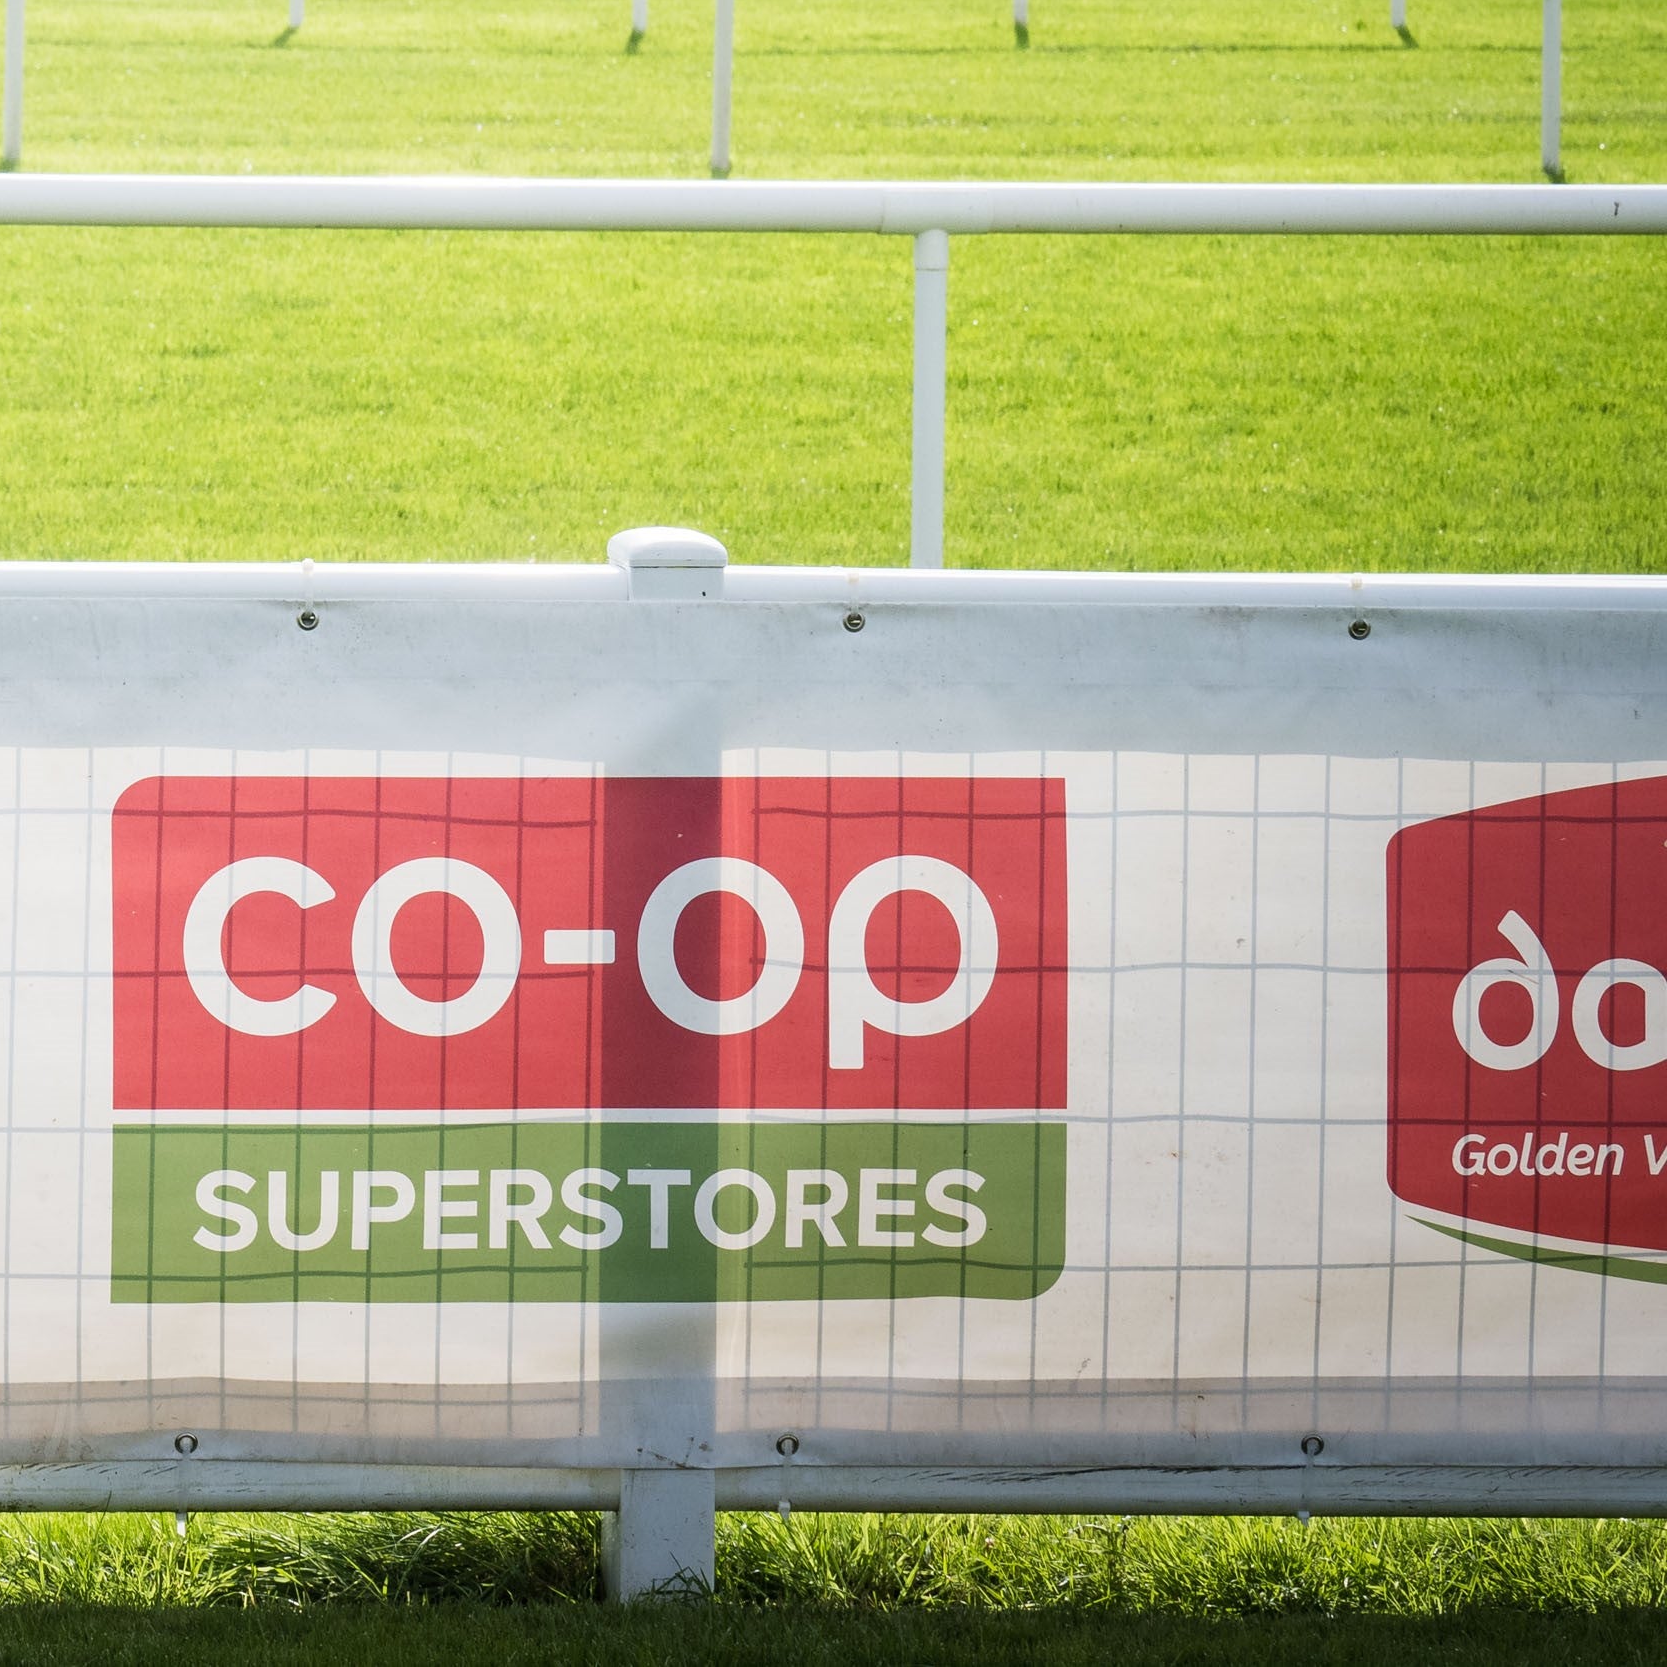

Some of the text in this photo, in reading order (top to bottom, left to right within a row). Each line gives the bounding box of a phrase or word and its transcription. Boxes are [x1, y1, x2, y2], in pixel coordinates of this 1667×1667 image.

[183, 855, 998, 1069] co-op
[1451, 1132, 1624, 1177] Golden
[193, 1167, 987, 1252] SUPERSTORES
